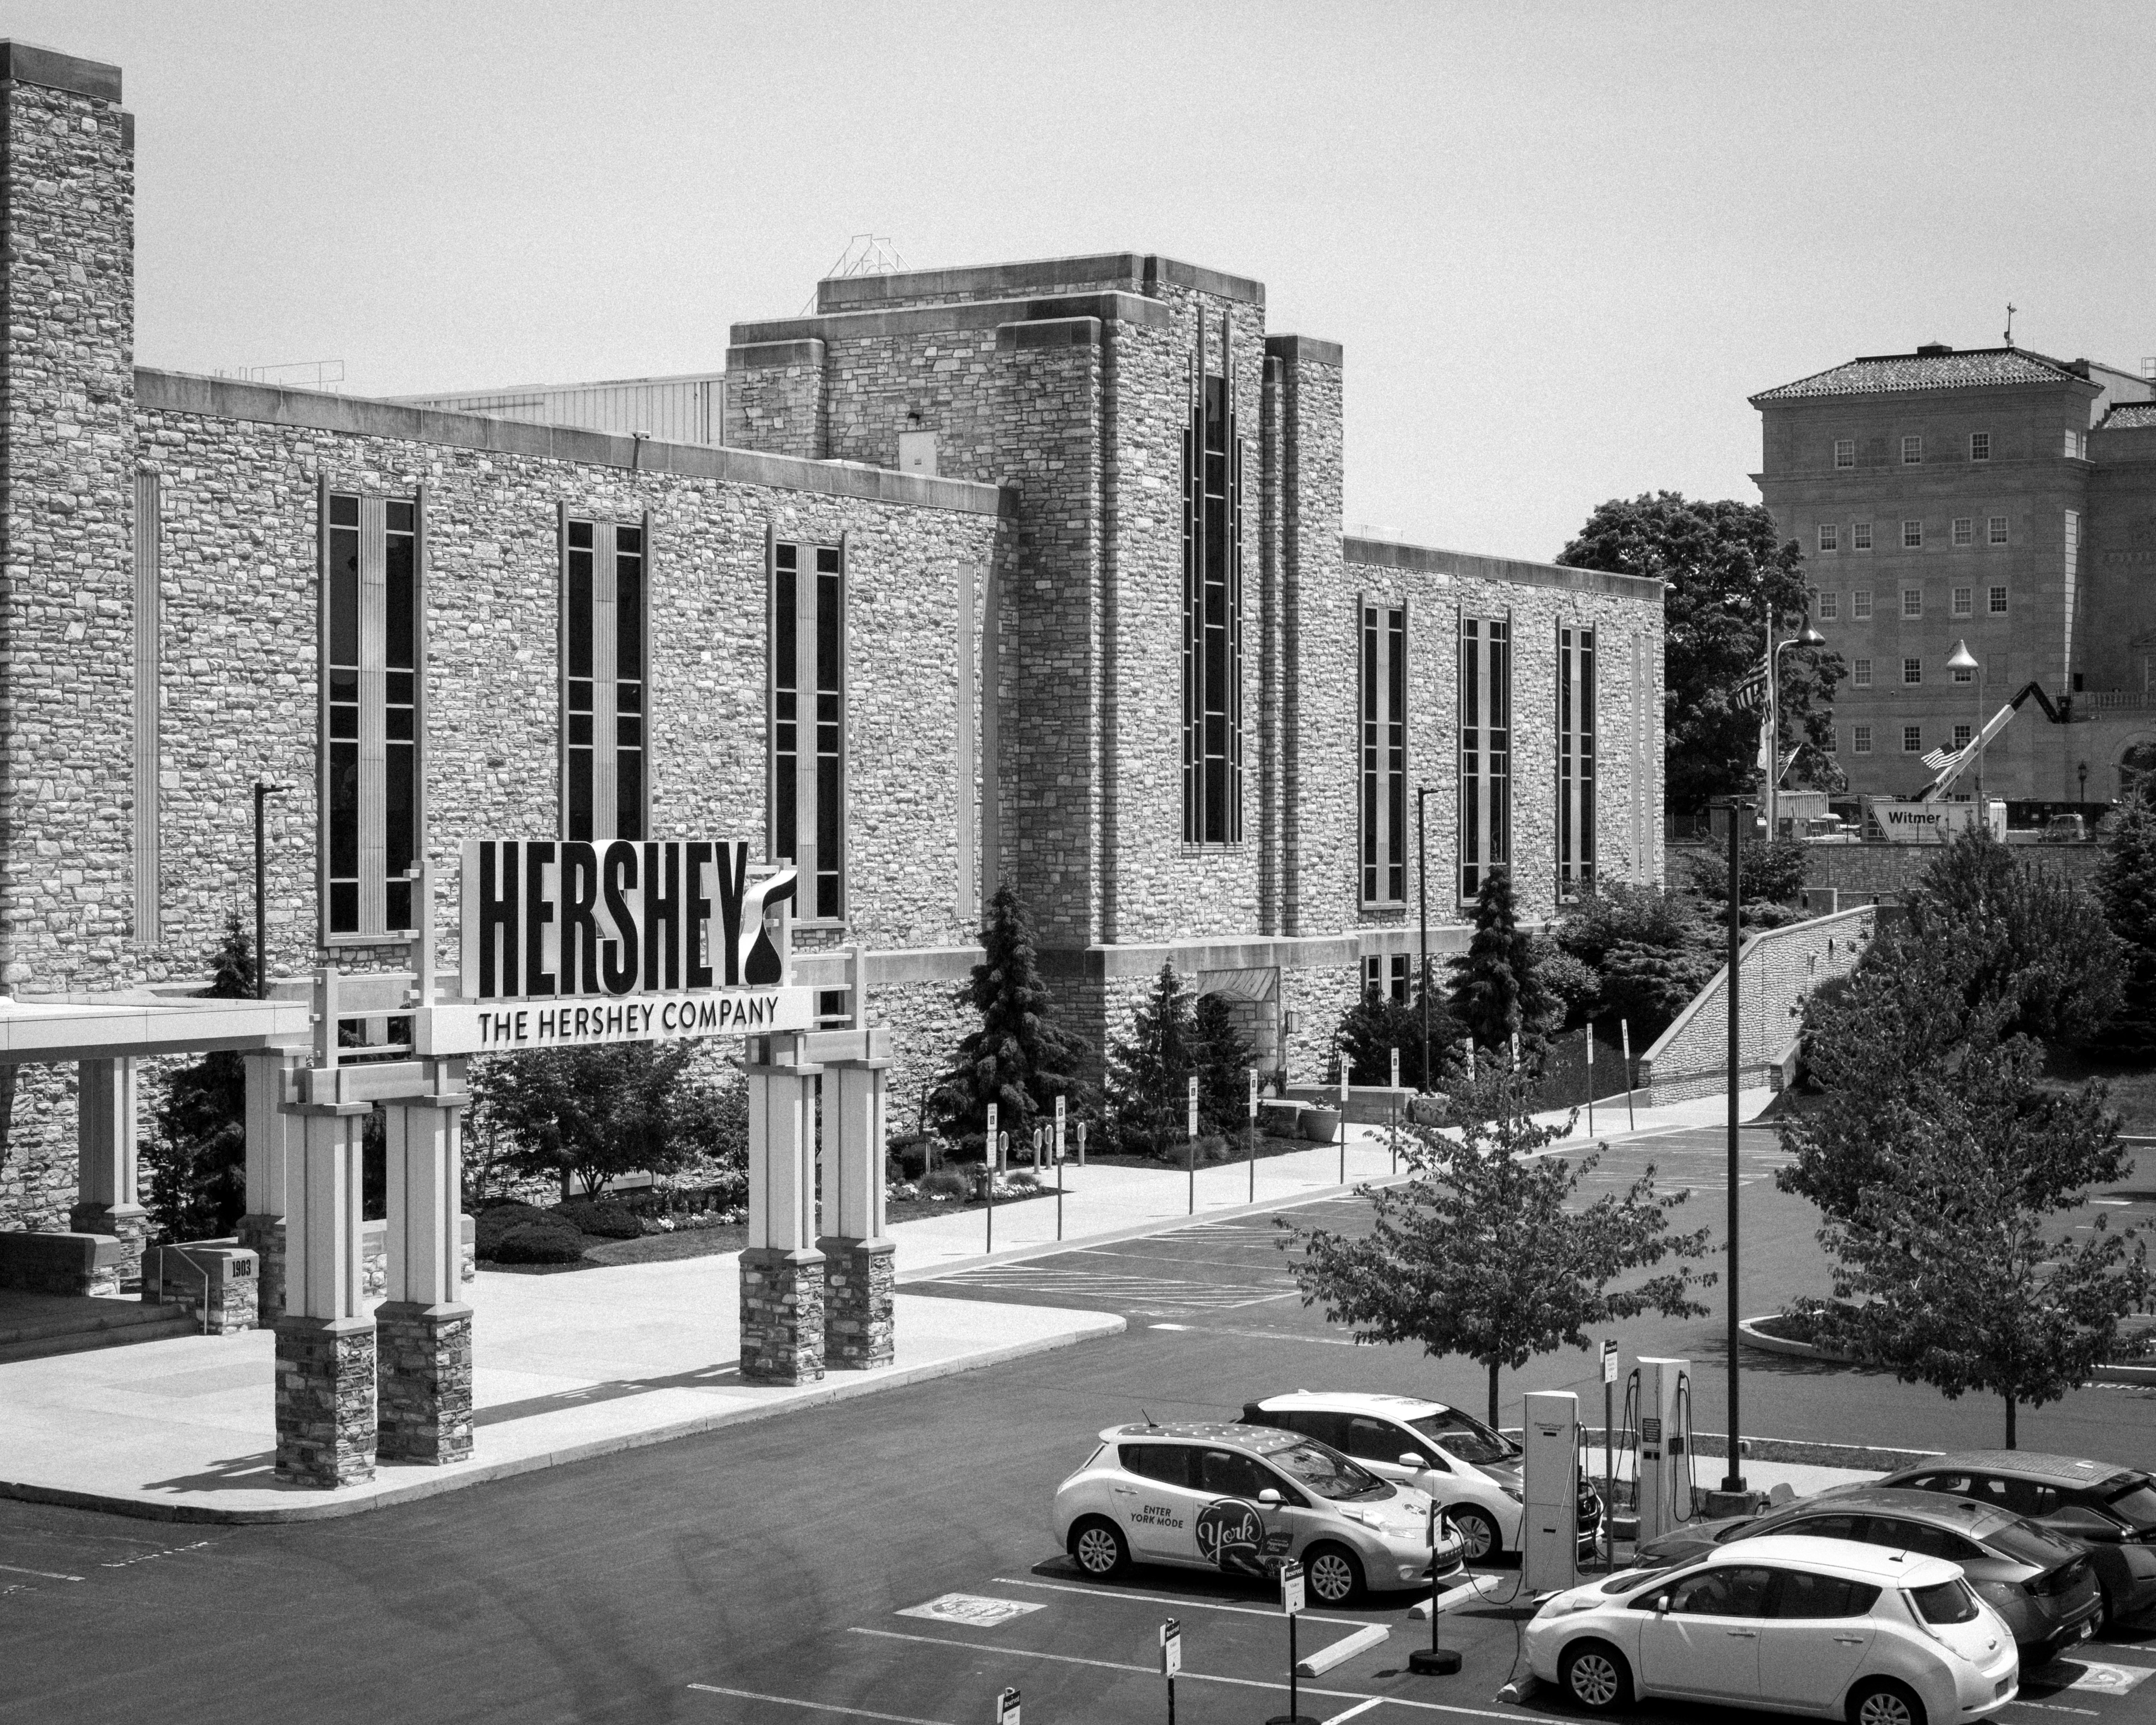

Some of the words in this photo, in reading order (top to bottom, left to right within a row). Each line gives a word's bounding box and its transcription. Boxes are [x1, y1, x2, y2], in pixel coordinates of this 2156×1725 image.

[1888, 811, 1941, 824] Witmer
[480, 840, 748, 997] HERSHEY
[479, 1011, 528, 1042] THE
[540, 1003, 655, 1038] HERSHEY
[663, 996, 779, 1030] COMPANY
[232, 1259, 251, 1278] 1903
[1144, 1505, 1171, 1517] ENTER
[1131, 1513, 1155, 1524] YORK
[1157, 1517, 1184, 1529] MODE
[1198, 1513, 1262, 1563] York
[1286, 1567, 1303, 1578] Reserved
[1166, 1625, 1180, 1638] Reserved
[1004, 1695, 1020, 1708] Reserved
